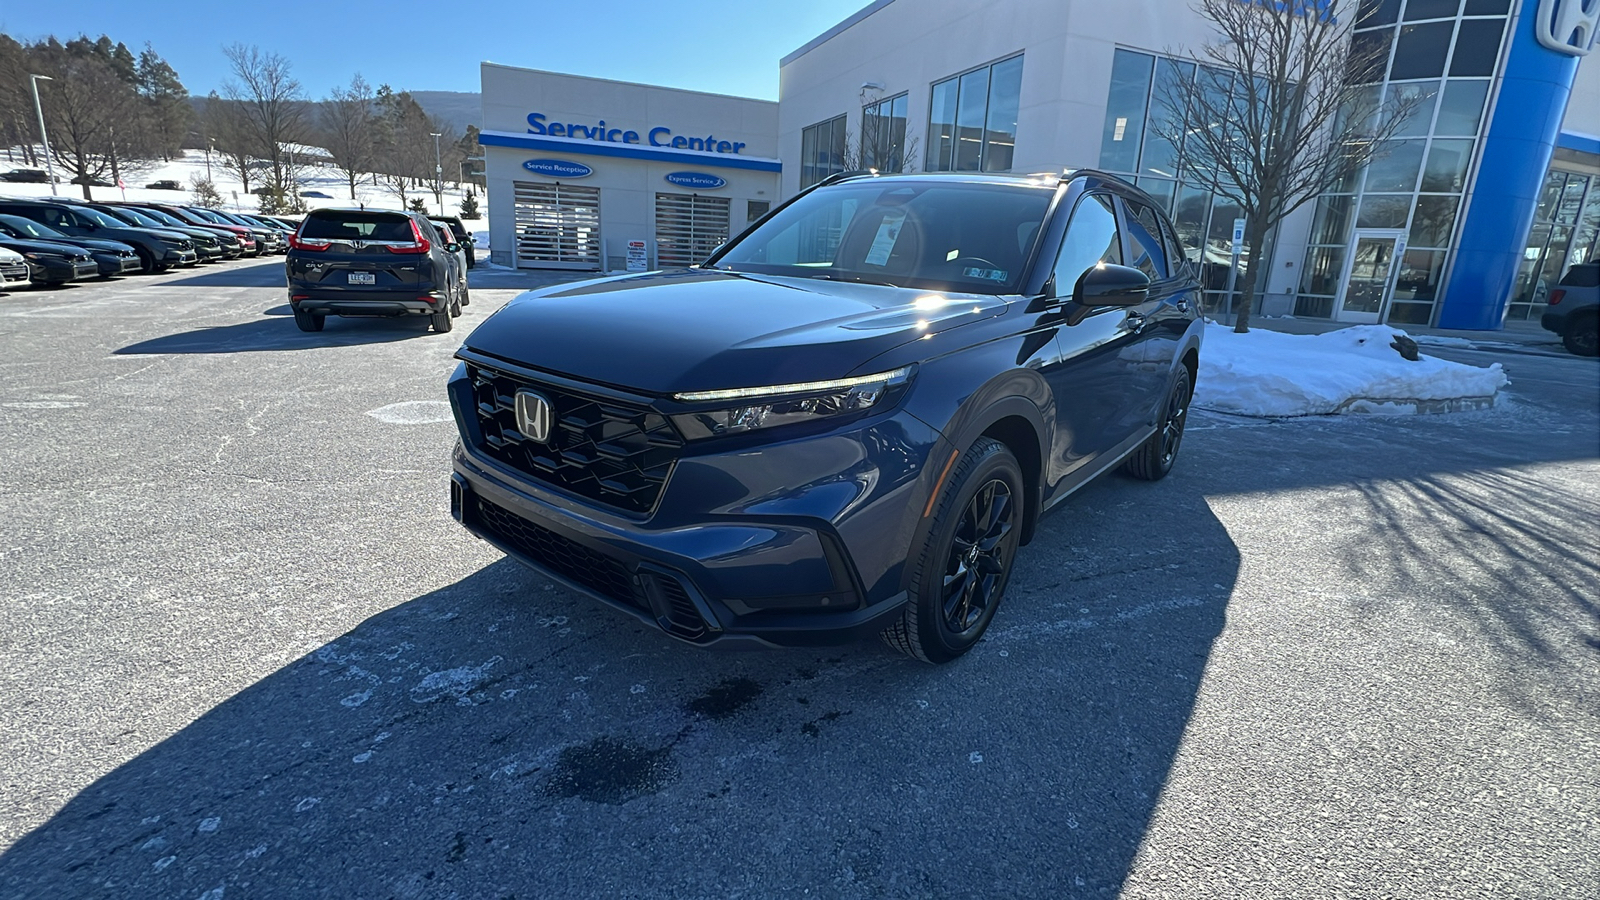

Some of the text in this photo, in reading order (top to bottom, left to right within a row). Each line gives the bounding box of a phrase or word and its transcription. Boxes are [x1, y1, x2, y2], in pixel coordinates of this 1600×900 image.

[526, 112, 746, 154] Service Center
[526, 162, 588, 174] Service Reception
[668, 175, 692, 183] Express
